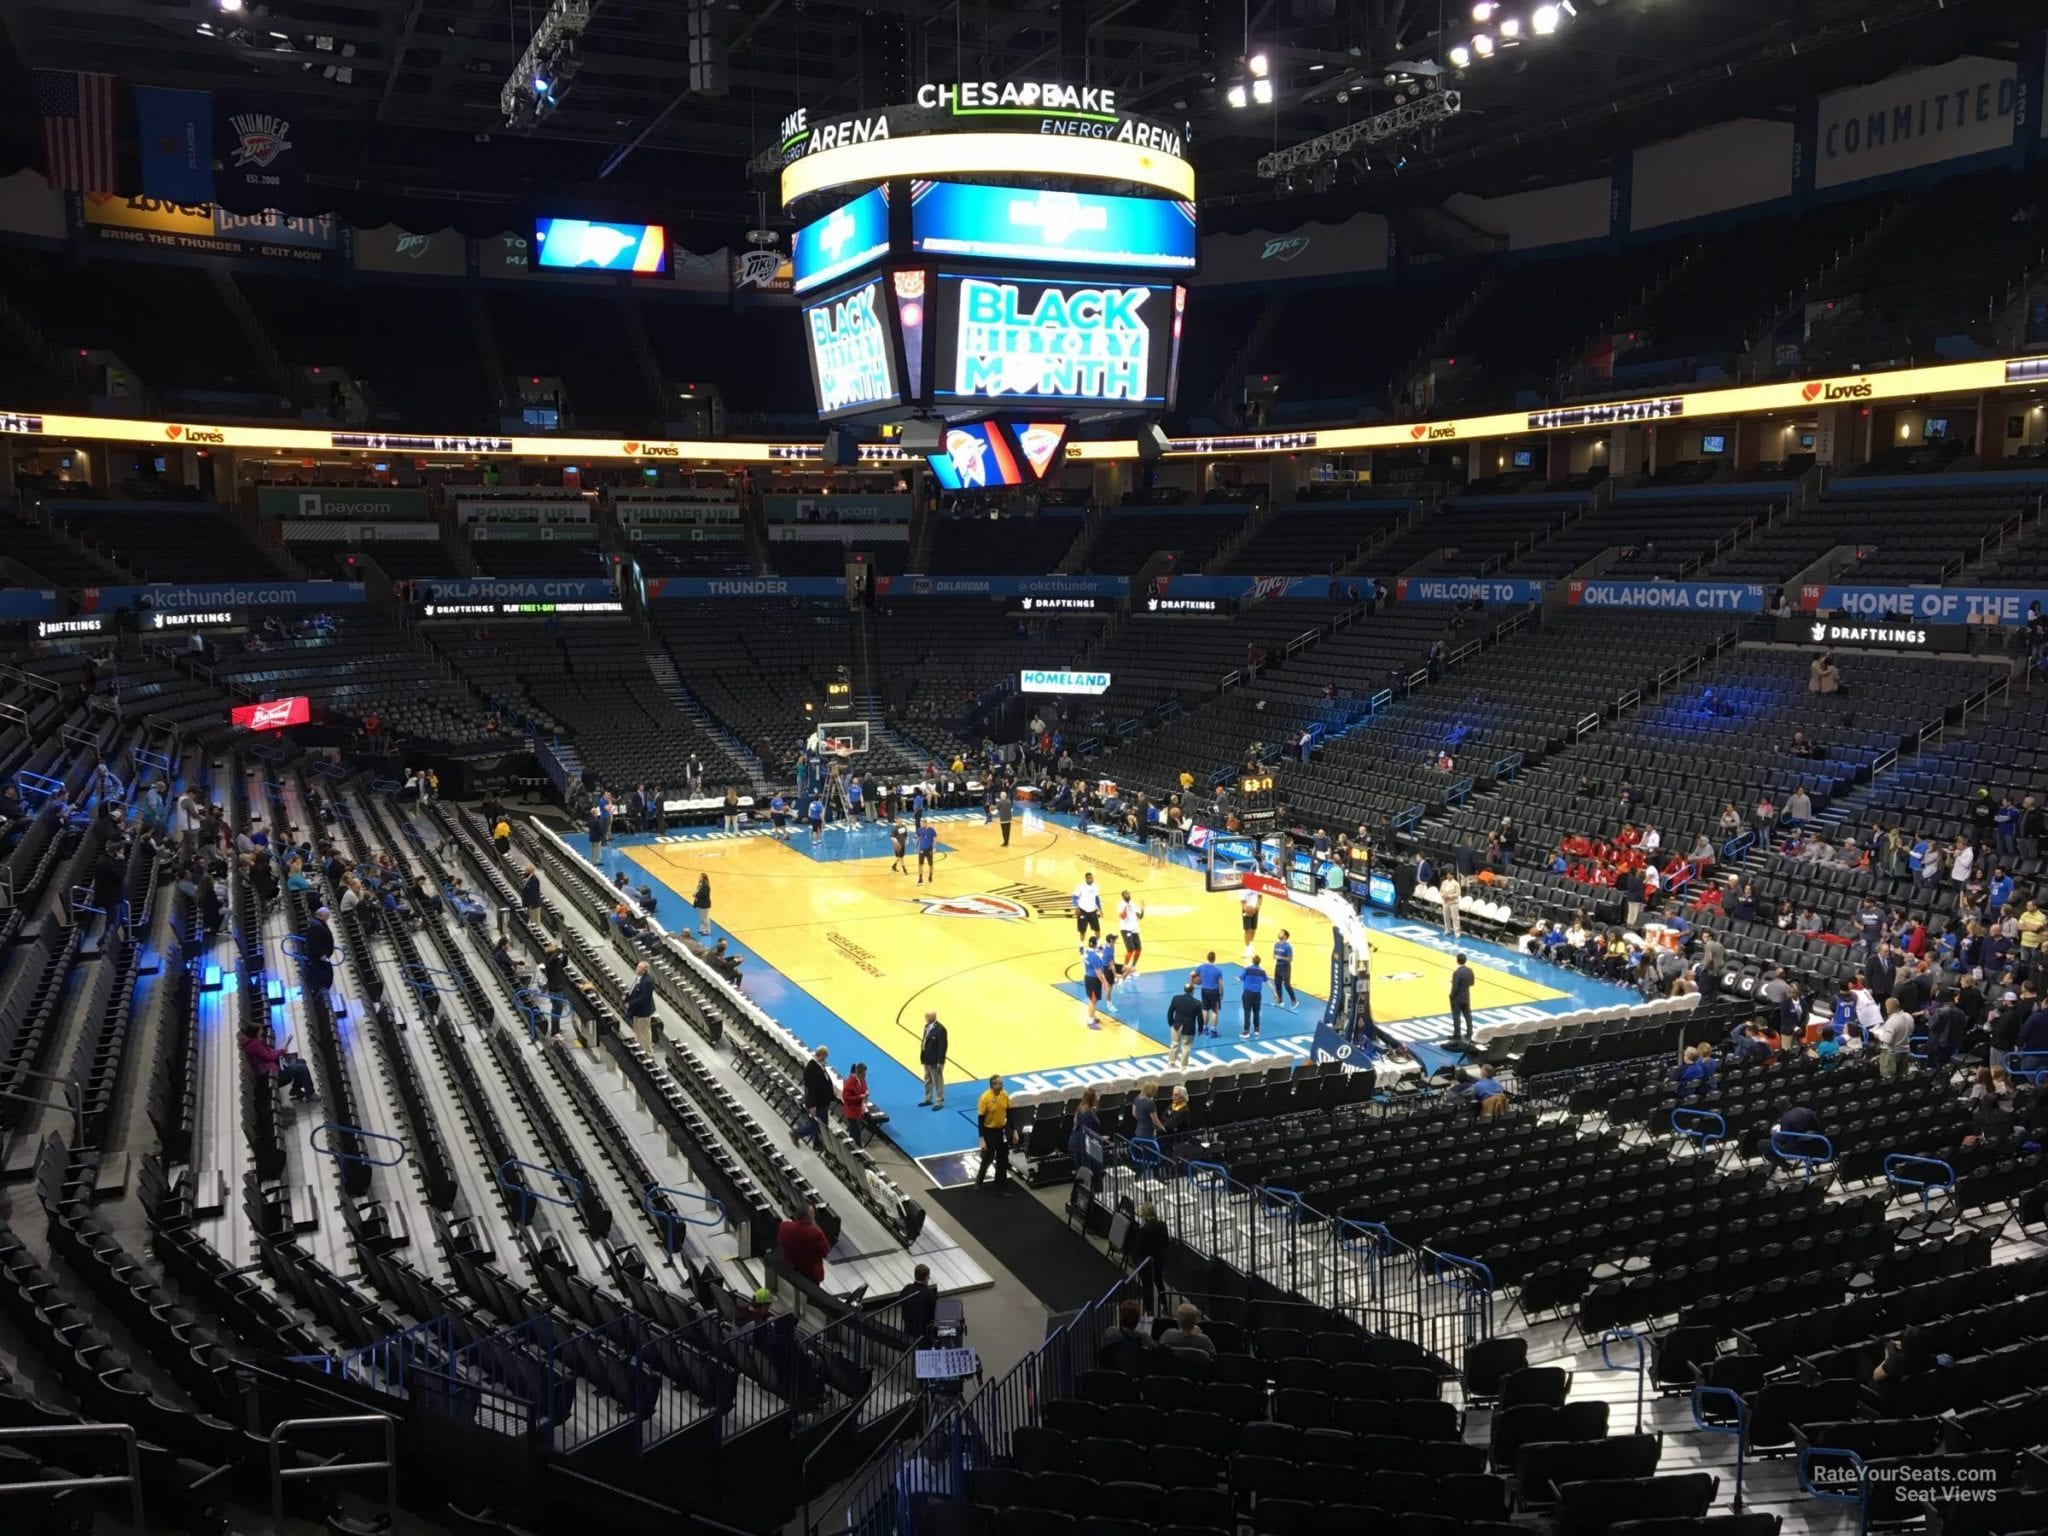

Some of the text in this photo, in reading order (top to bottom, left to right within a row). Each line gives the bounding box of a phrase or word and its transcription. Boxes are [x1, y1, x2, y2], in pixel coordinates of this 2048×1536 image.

[917, 82, 1117, 114] CHESAPEAKE
[229, 112, 290, 141] THUNDER
[1826, 78, 2015, 158] COMMITTED
[808, 115, 890, 155] ARENA
[1041, 119, 1182, 158] ENERGY ARENA
[100, 228, 322, 260] BRING THE THUNDER EXIT NOW
[1262, 237, 1302, 258] OKC
[967, 280, 1142, 330] BLACK
[813, 288, 878, 347] BLACK
[966, 327, 1142, 360] HISTORY
[964, 354, 1140, 397] MNTH
[324, 501, 392, 516] paycom
[543, 582, 587, 597] CITY
[707, 581, 788, 595] THUNDER
[936, 581, 990, 592] OKLAHOMA
[1420, 583, 1514, 601] WELCOME TO
[1802, 587, 1820, 599] 116
[1036, 598, 1095, 609] DRAFTKINGS
[1161, 599, 1216, 611] DRAFTKINGS
[1584, 587, 1744, 609] OKLAHOMA CITY
[1842, 592, 2021, 620] HOME OF THE
[166, 612, 232, 625] DRAFTKINGS
[436, 604, 495, 614] DRAFTKINGS
[46, 619, 102, 633] DRAFTKINGS
[1831, 626, 1927, 644] DRAFTKINGS
[1023, 671, 1108, 688] HOMELAND
